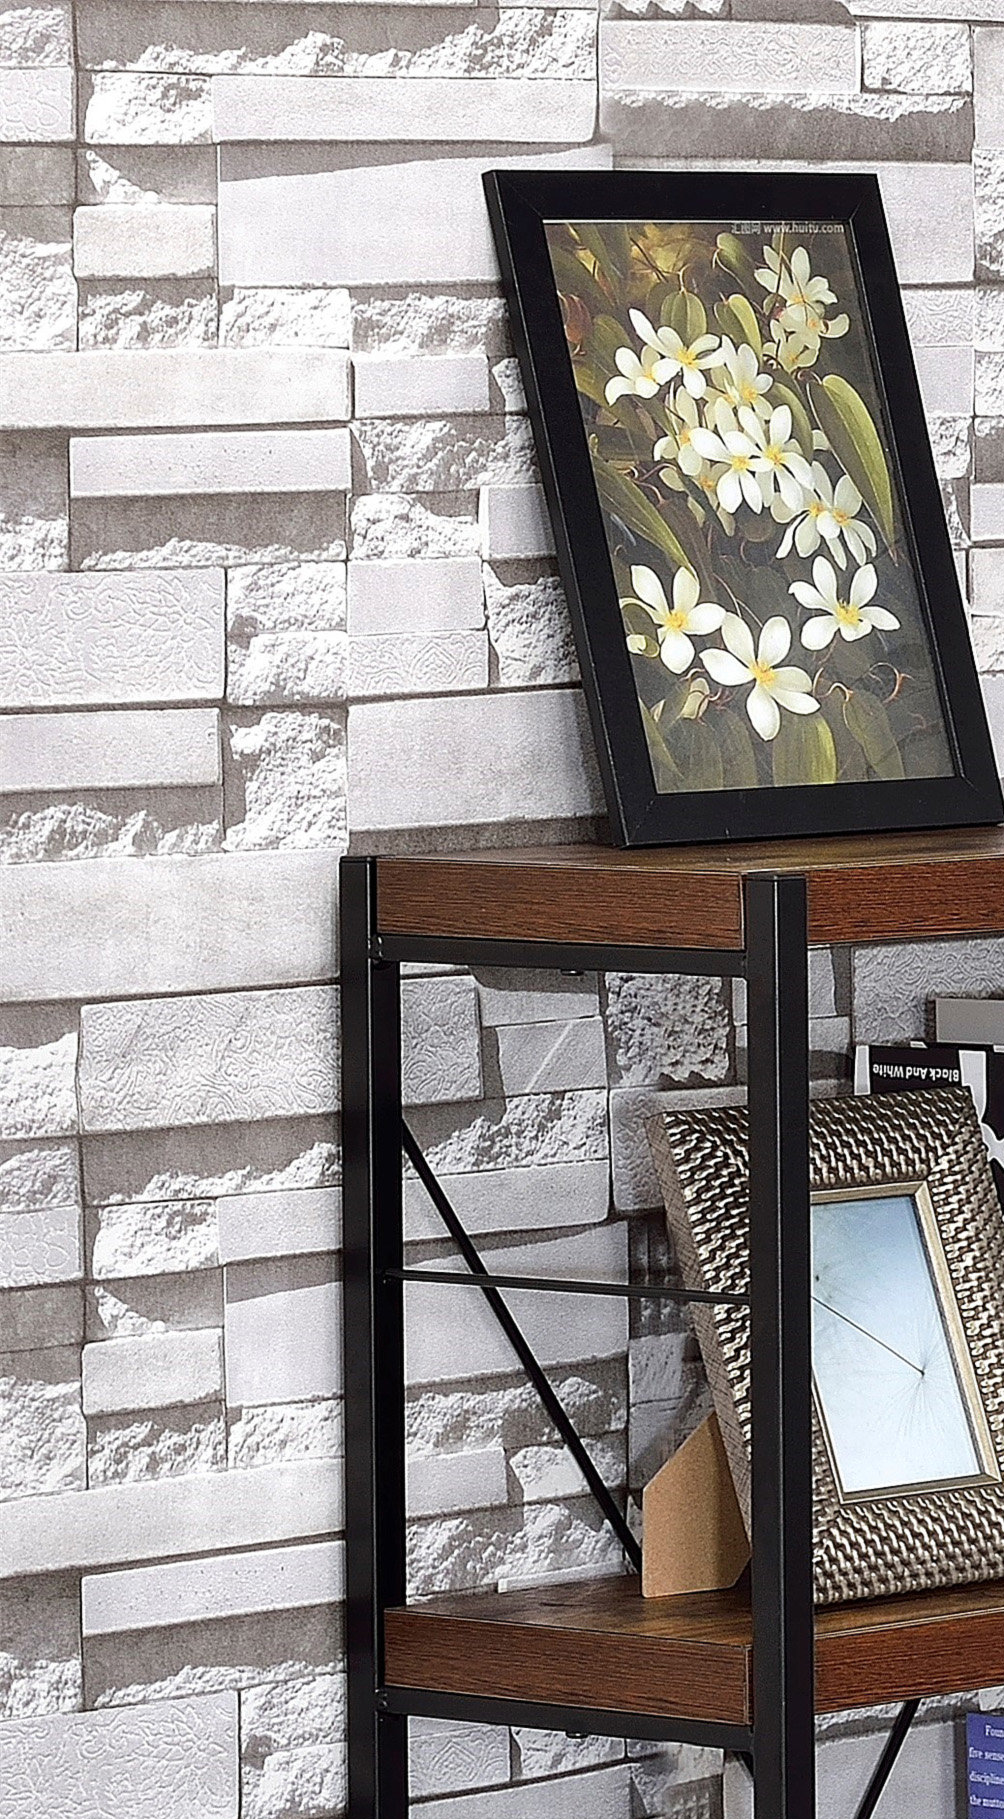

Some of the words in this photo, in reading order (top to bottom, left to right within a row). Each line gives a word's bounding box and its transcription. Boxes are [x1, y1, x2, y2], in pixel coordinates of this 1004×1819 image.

[763, 222, 845, 233] www.huitu.com
[872, 1063, 905, 1079] White
[905, 1066, 928, 1080] And
[929, 1068, 960, 1082] Black
[968, 1746, 982, 1758] five
[969, 1794, 982, 1806] the
